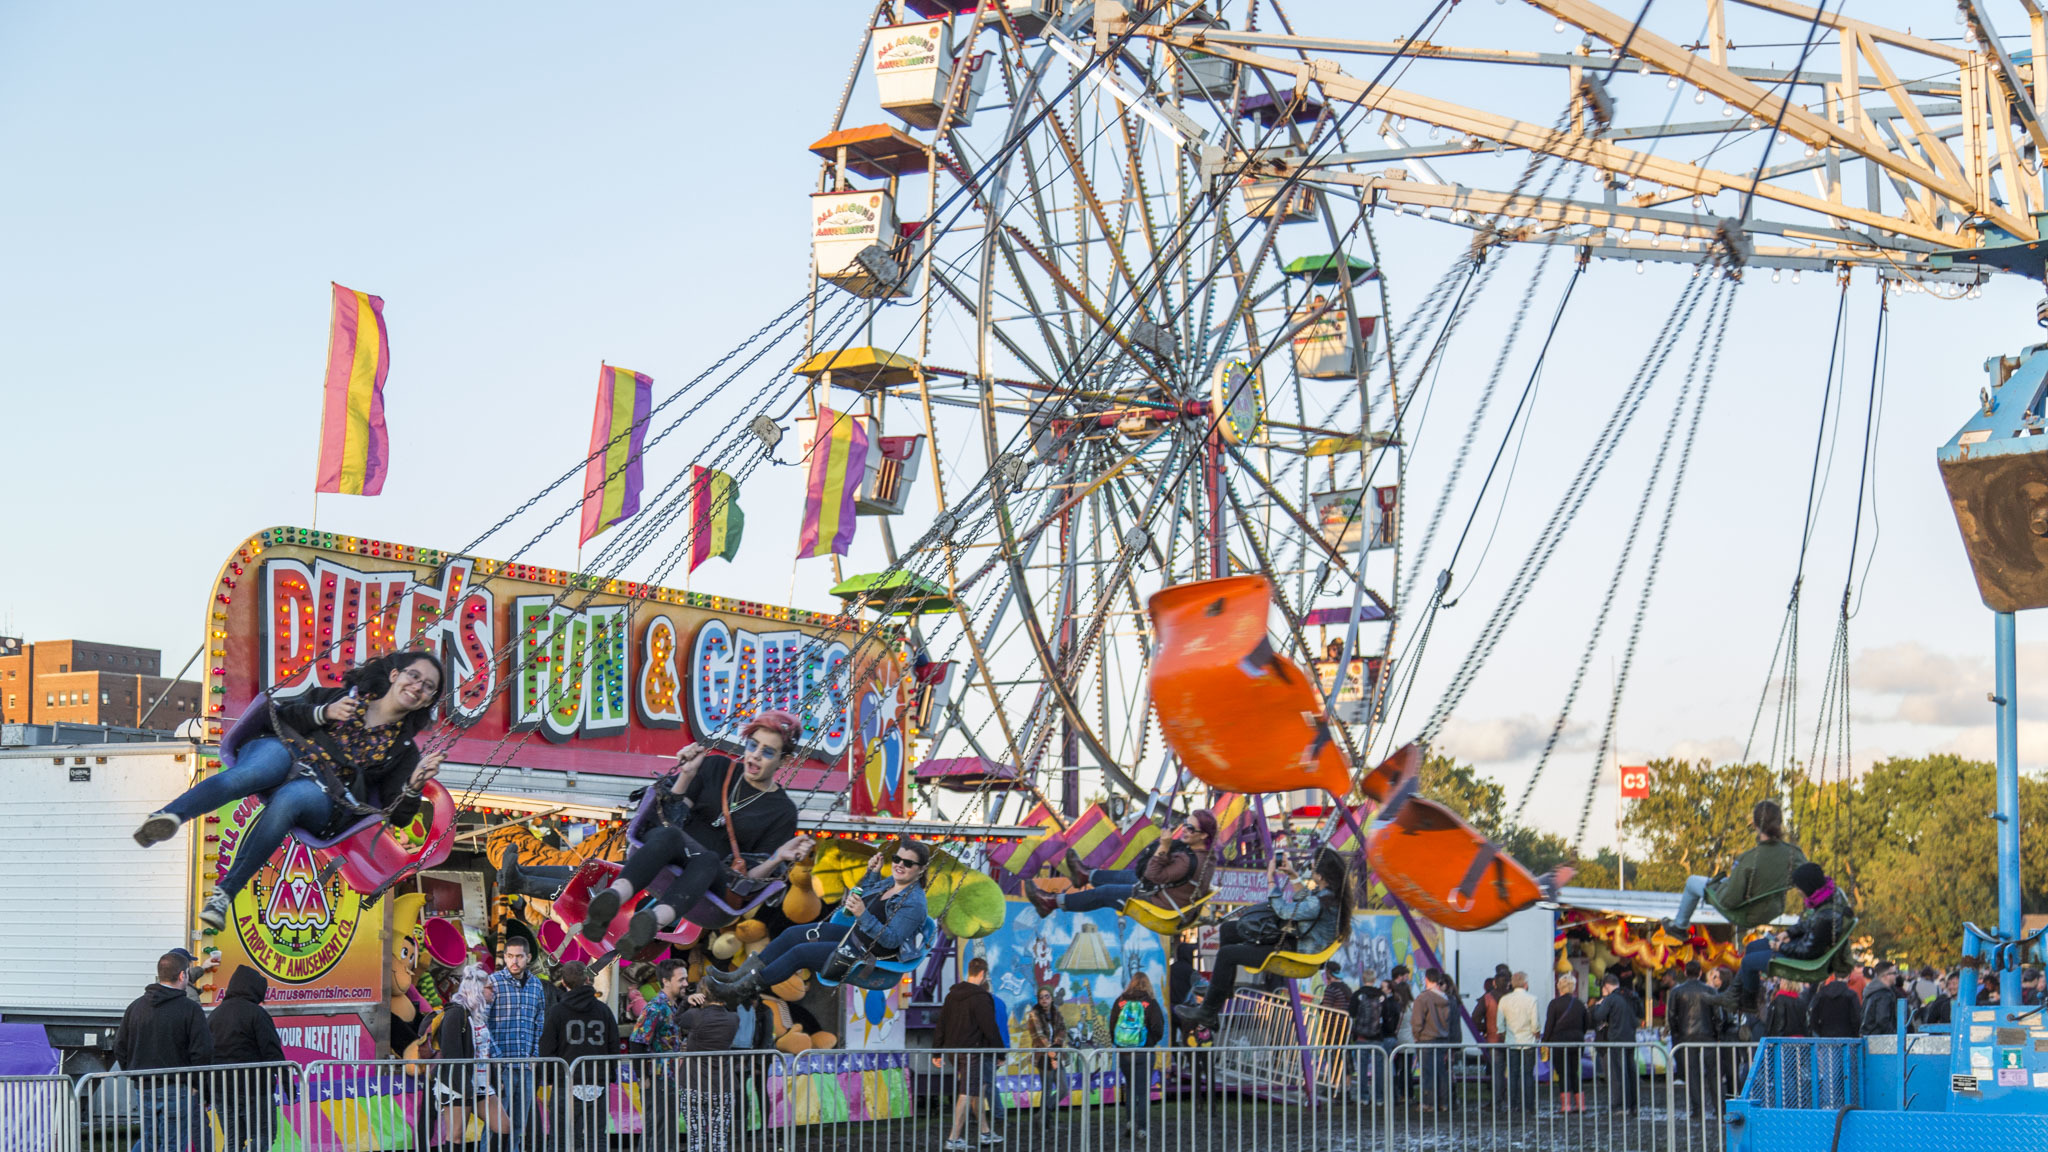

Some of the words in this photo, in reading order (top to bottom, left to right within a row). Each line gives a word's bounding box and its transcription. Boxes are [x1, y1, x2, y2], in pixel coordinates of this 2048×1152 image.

[816, 208, 834, 225] ALL
[835, 202, 875, 221] AROUND
[267, 557, 495, 718] DUKE'S
[517, 594, 629, 735] FUN
[638, 614, 684, 723] &
[693, 618, 852, 756] GAMES
[1623, 773, 1646, 789] C3
[239, 915, 252, 928] A
[338, 919, 354, 939] CO.
[243, 922, 273, 966] TRIPLE
[286, 933, 343, 977] AMUSEMENT
[304, 1026, 330, 1054] NEXT
[331, 1025, 361, 1063] EVENT
[566, 1020, 606, 1045] 03
